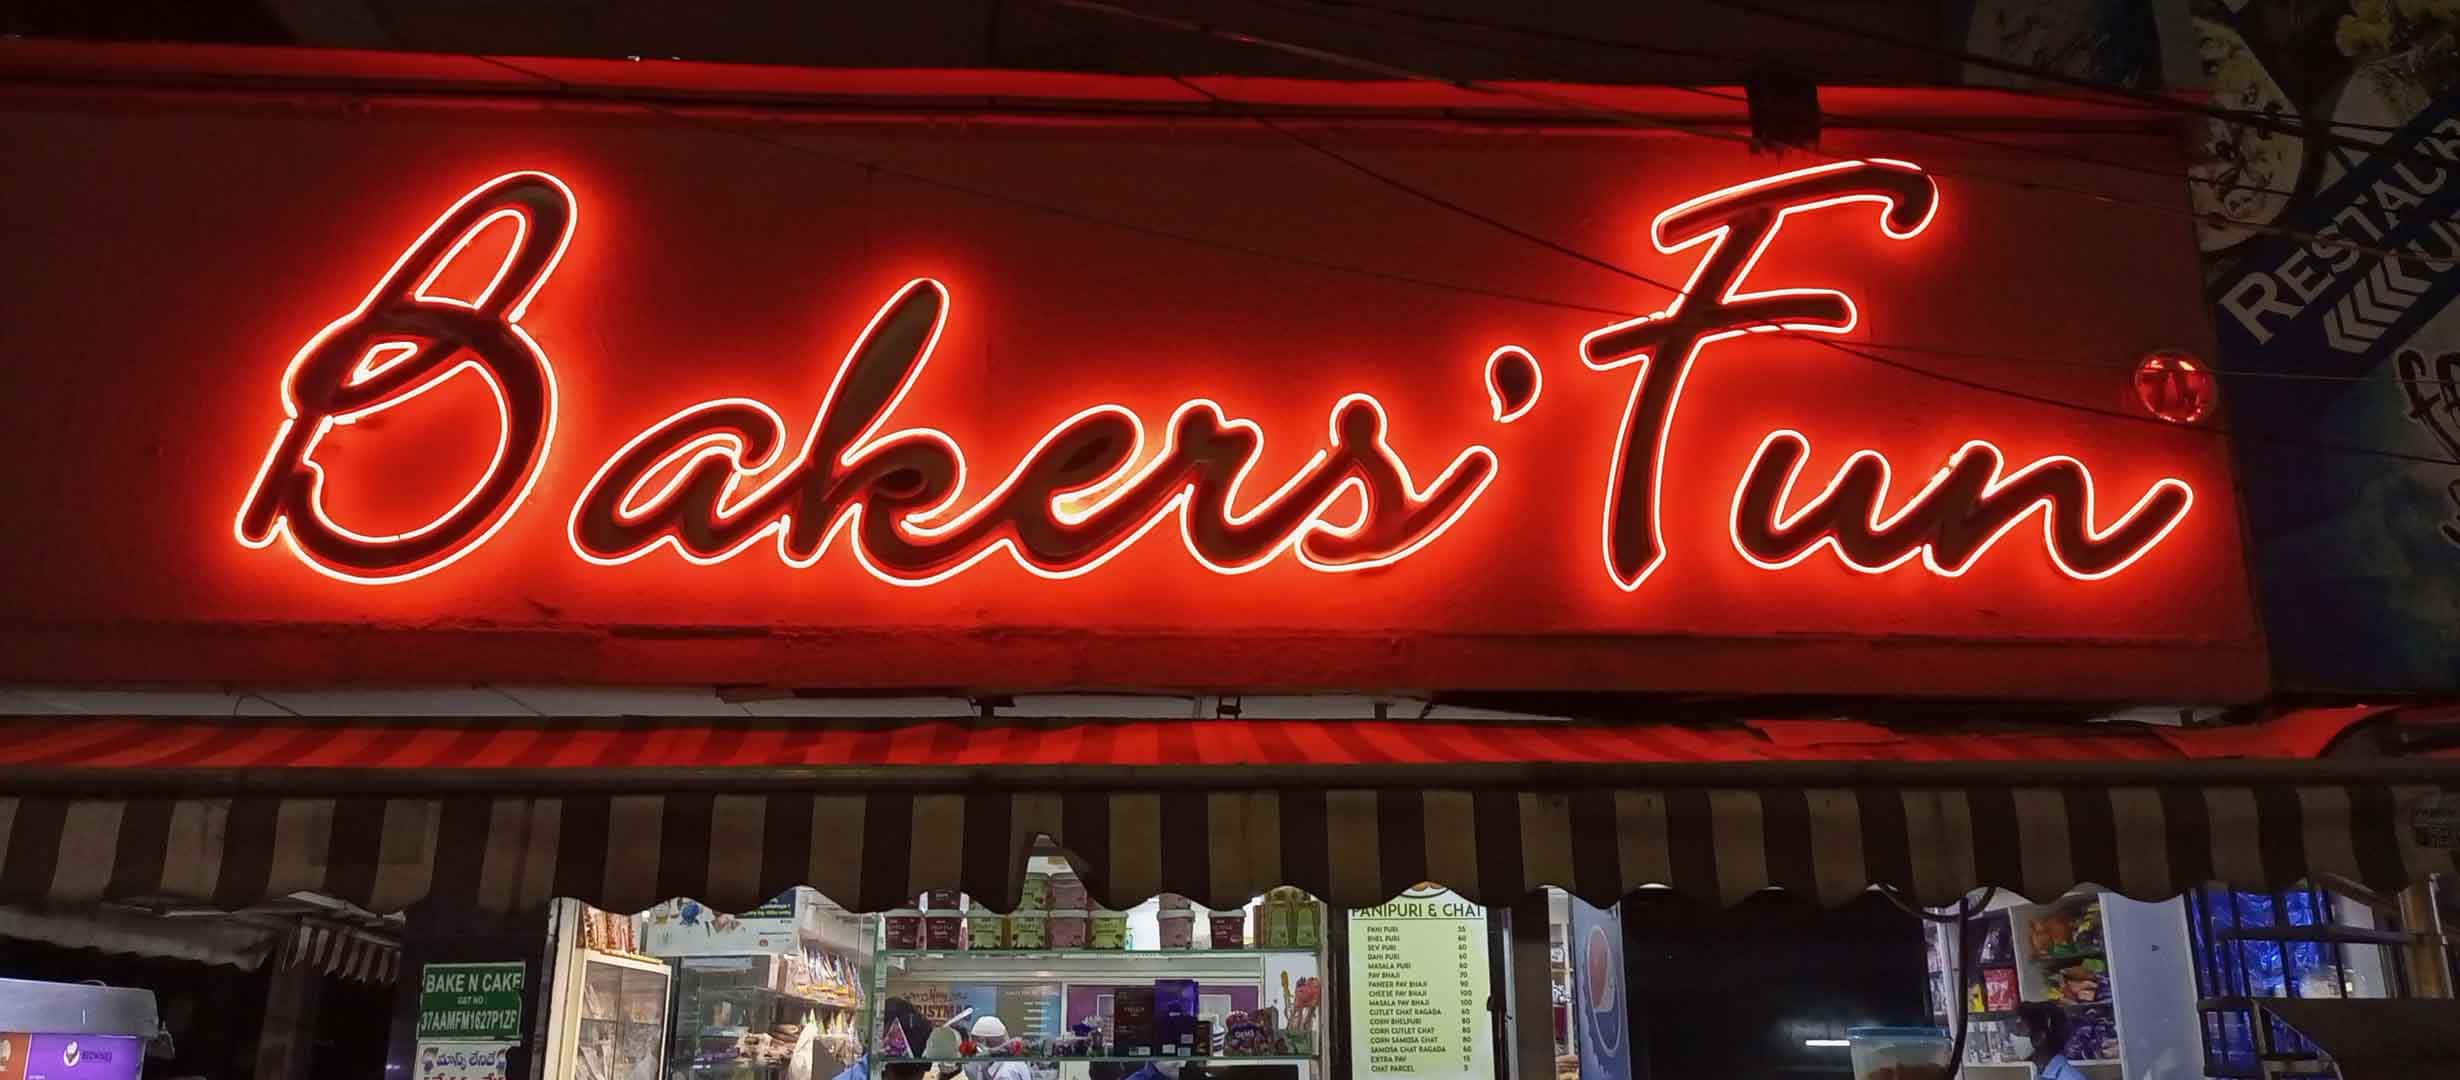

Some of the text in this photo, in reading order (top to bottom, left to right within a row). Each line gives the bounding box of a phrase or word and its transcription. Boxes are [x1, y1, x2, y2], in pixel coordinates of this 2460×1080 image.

[1579, 158, 2193, 592] Fun
[1428, 903, 1437, 917] &
[426, 974, 465, 992] BAKE
[469, 974, 479, 992] N
[1460, 989, 1472, 997] 100
